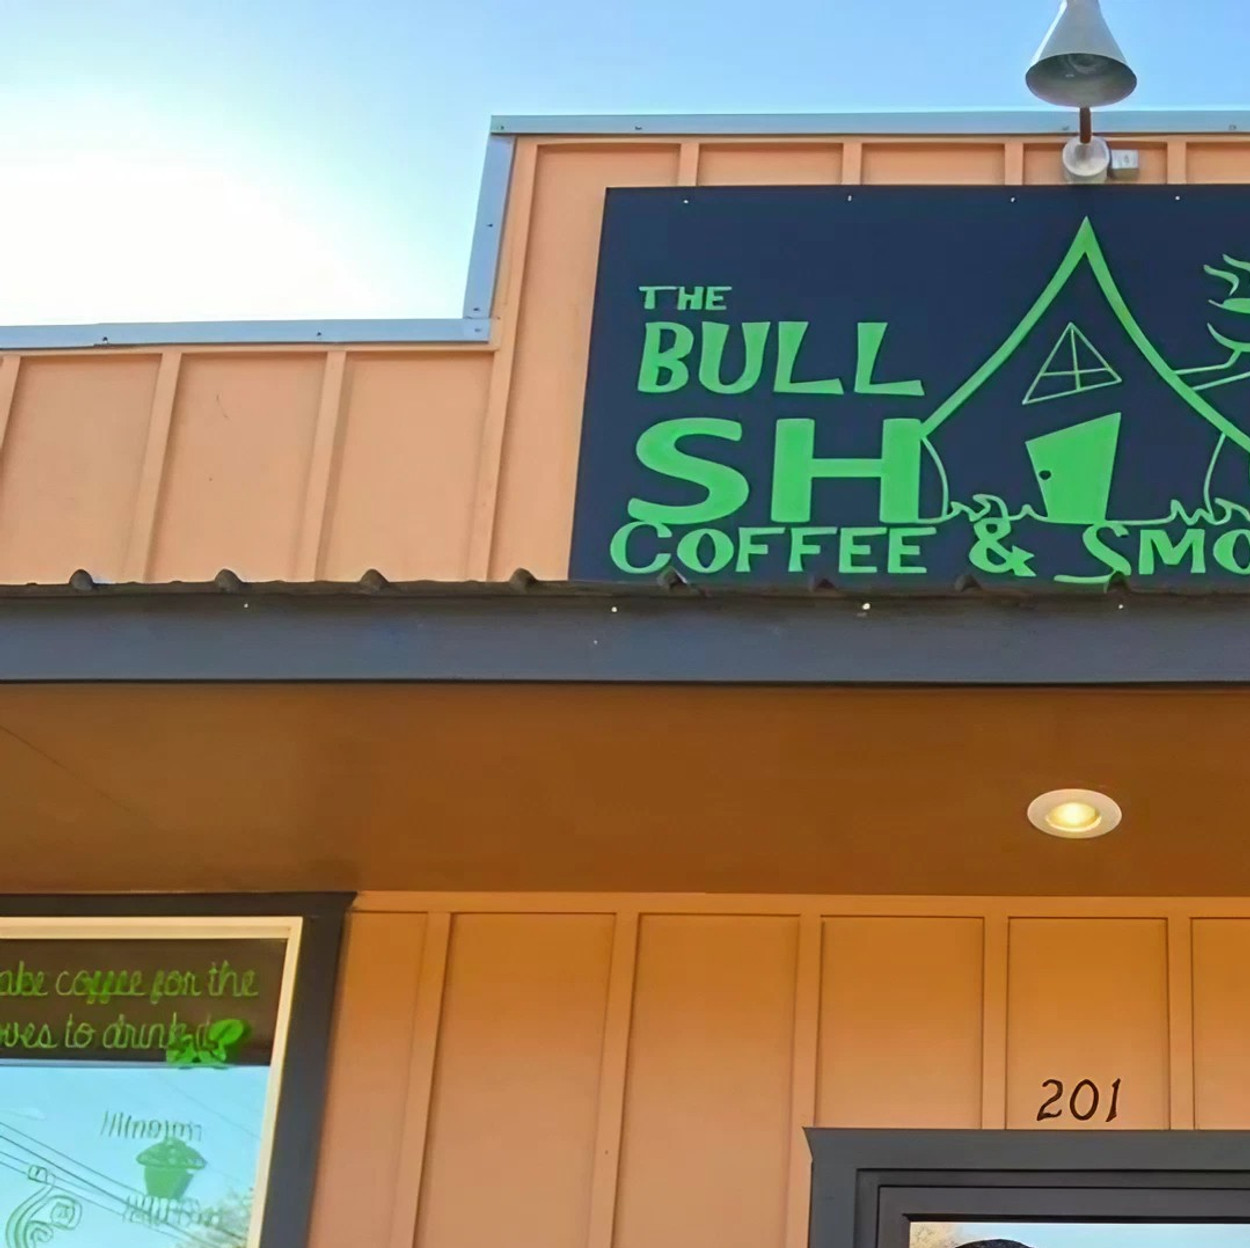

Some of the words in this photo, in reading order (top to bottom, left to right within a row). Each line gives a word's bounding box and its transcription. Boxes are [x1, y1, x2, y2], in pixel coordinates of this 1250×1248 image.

[639, 285, 732, 311] THE
[637, 320, 925, 396] BULL
[609, 521, 938, 575] COFFEE
[968, 517, 1037, 577] &
[0, 960, 48, 997] ake
[207, 960, 259, 997] the
[0, 1022, 57, 1049] ves
[65, 1013, 96, 1049] to
[1037, 1078, 1121, 1122] 201
